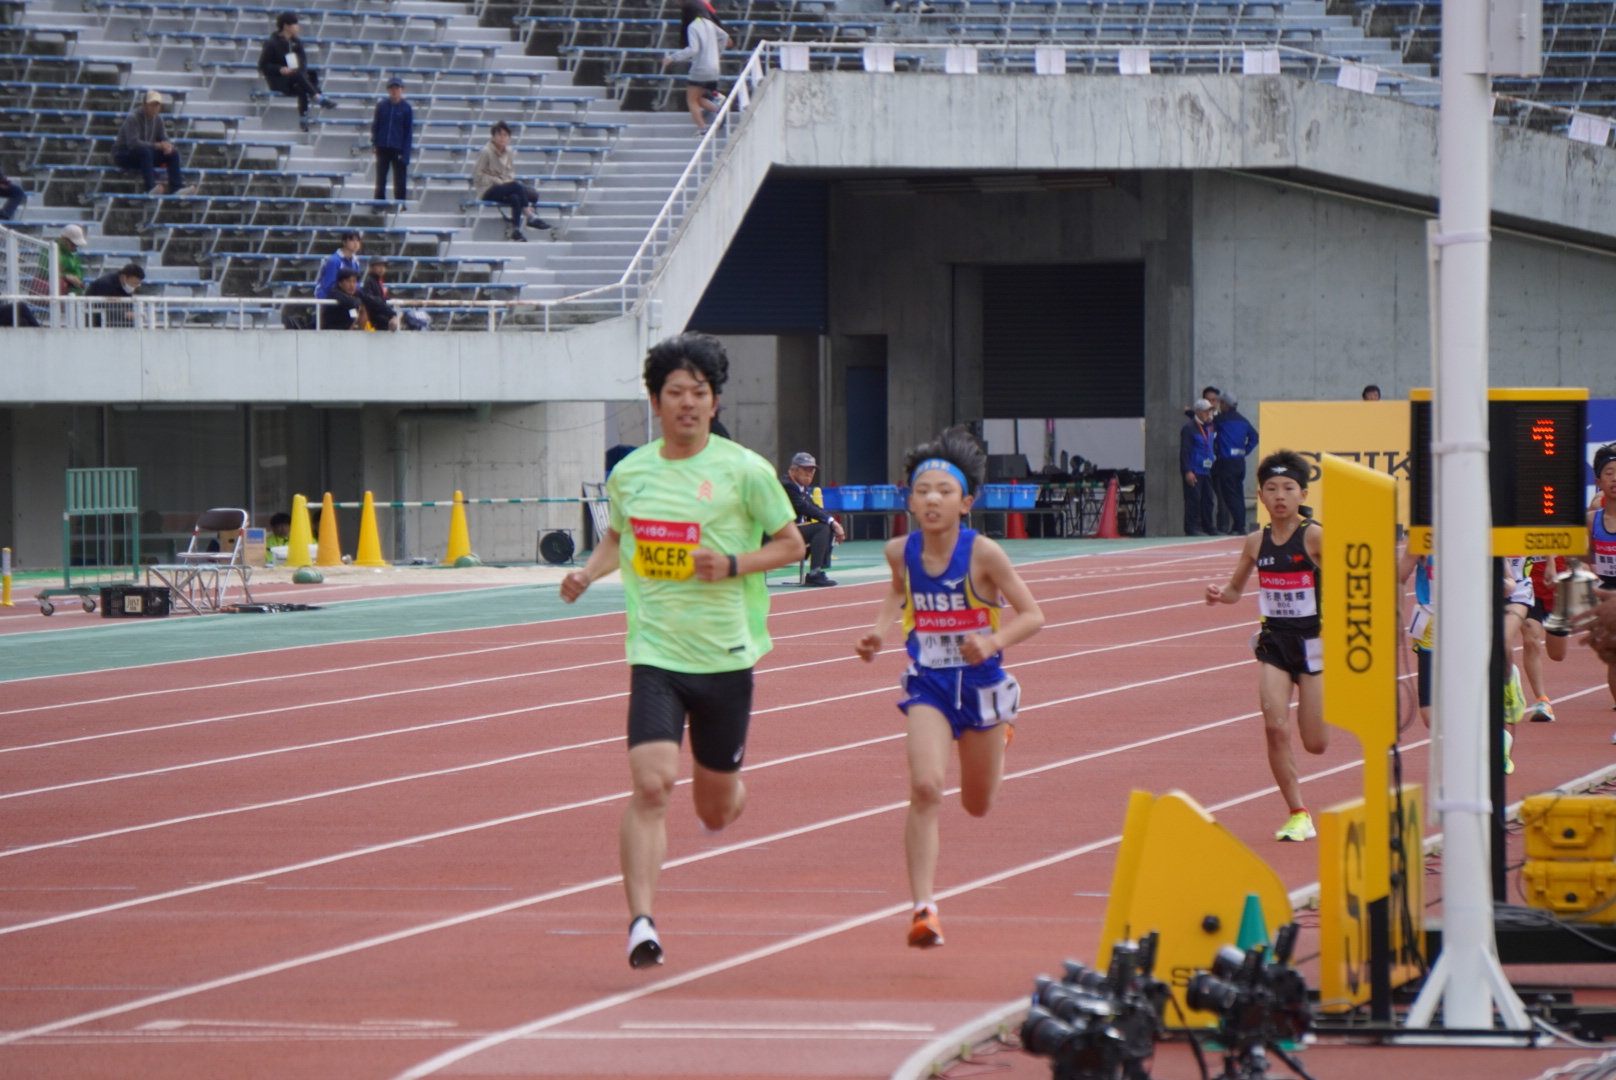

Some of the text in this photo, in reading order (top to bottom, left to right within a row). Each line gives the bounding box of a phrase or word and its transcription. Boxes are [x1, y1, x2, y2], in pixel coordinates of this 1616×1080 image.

[1524, 532, 1572, 551] SEIKO
[913, 593, 966, 612] RISE
[1345, 543, 1373, 673] SEIKO
[918, 617, 957, 628] DAISO
